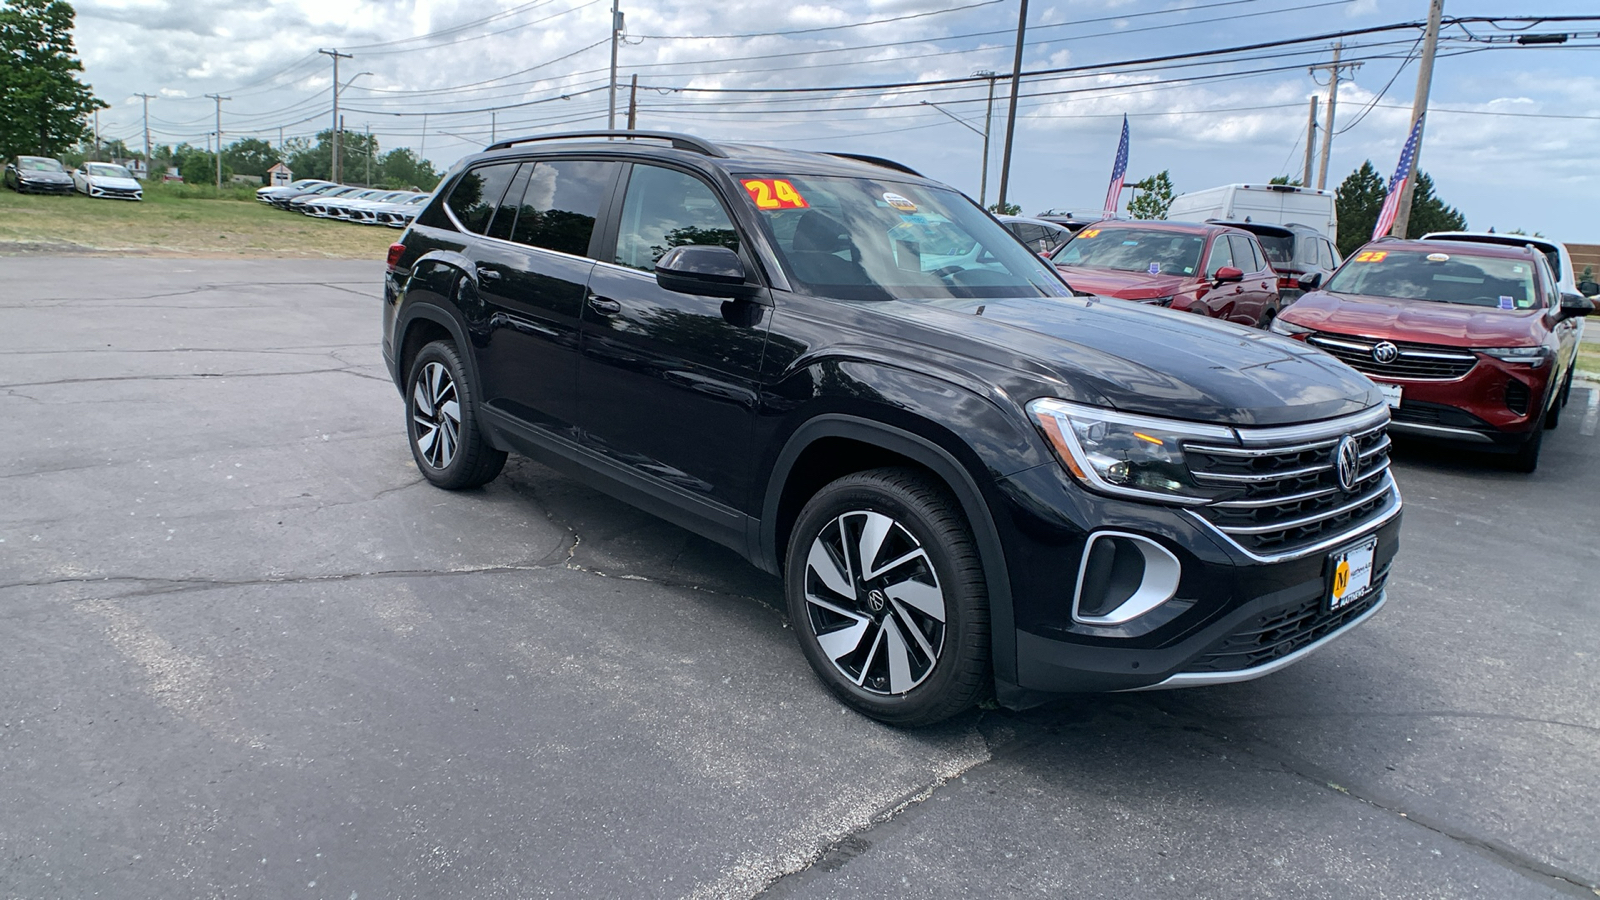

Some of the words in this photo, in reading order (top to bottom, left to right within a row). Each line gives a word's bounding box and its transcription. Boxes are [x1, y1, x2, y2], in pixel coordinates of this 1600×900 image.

[745, 180, 804, 208] 24
[1077, 229, 1101, 238] 24
[1356, 251, 1388, 263] 23
[1336, 570, 1348, 591] M
